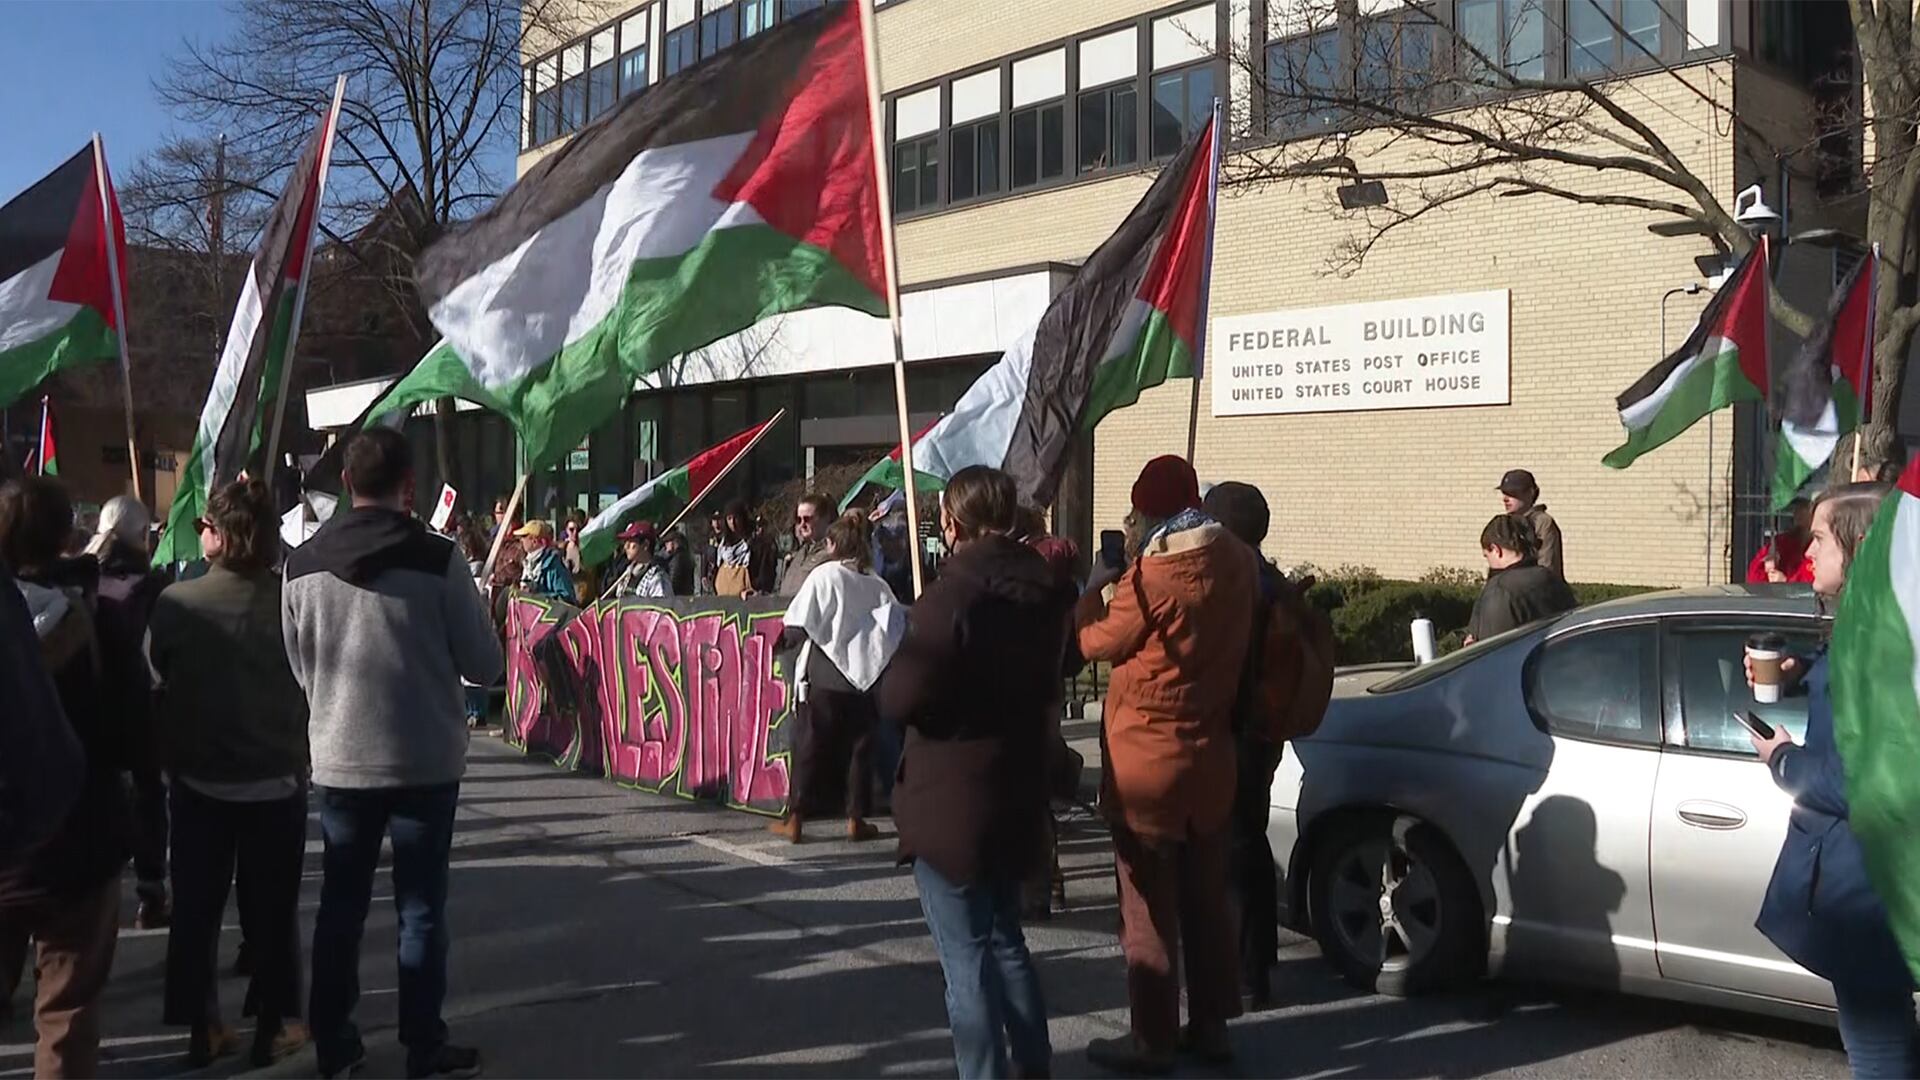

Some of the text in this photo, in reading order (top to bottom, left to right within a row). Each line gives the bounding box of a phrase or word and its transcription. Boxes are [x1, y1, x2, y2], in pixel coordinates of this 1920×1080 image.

[1229, 311, 1485, 352] FEDERAL BUILDING
[1232, 349, 1481, 379] UNITED STATES POST OFFICE
[1231, 375, 1481, 402] UNITED STATES COURT HOUSE
